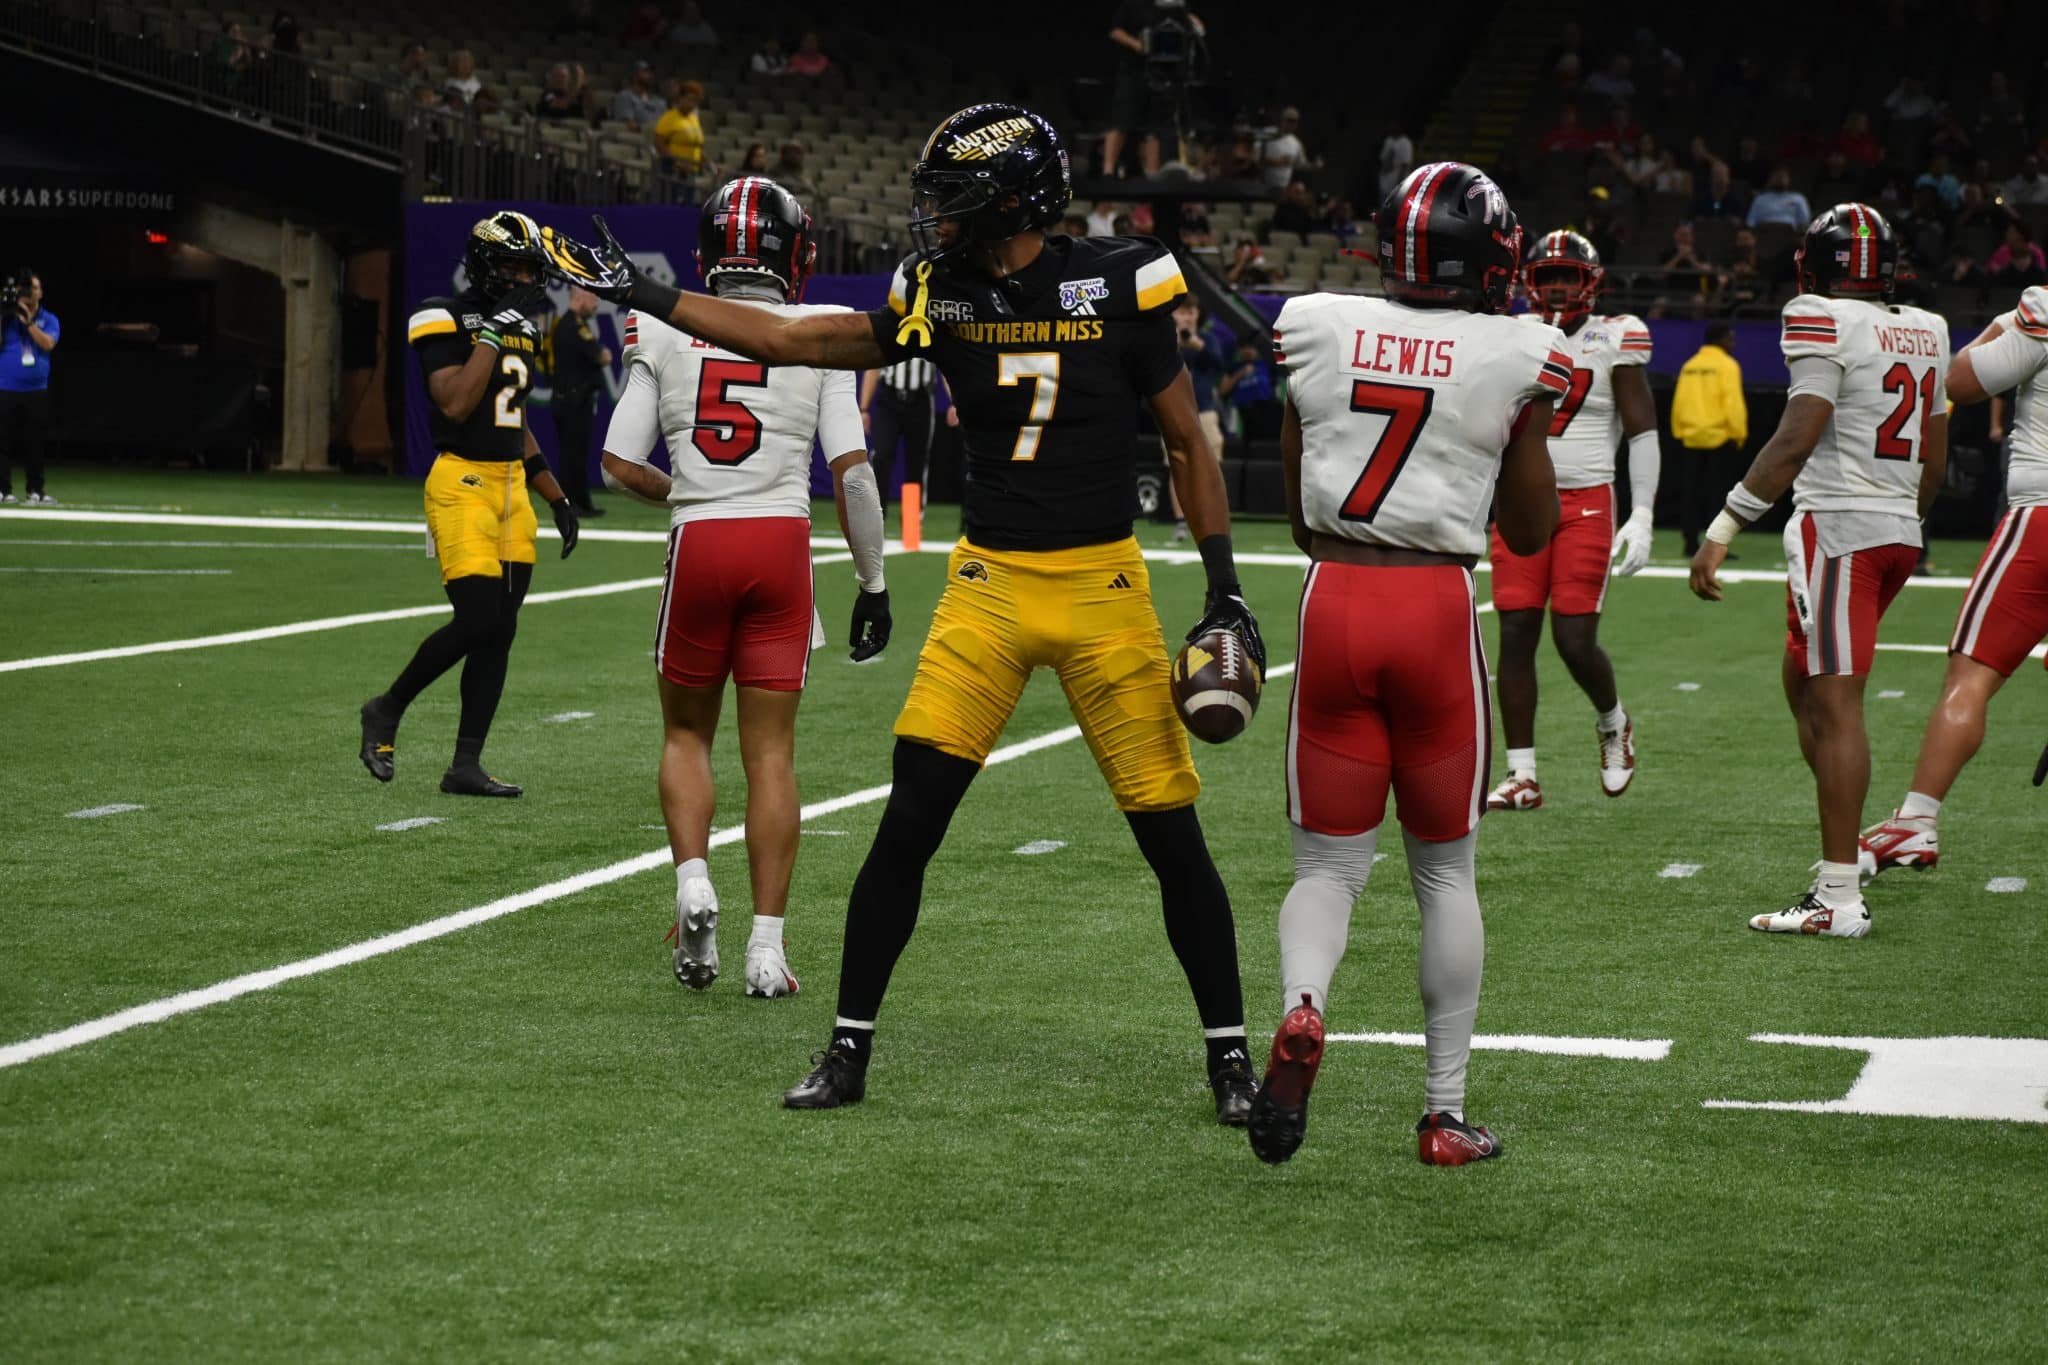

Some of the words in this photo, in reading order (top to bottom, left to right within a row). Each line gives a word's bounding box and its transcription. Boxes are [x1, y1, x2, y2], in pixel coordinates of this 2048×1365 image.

[946, 117, 1034, 157] SOUTHERN
[979, 134, 1017, 158] MISS
[67, 190, 174, 210] SUPERDOME
[1056, 320, 1104, 342] MISS
[1352, 330, 1454, 377] LEWIS
[1874, 325, 1939, 357] WESTER
[494, 353, 529, 429] 2
[691, 357, 768, 466] 5
[997, 352, 1061, 462] 7
[1874, 361, 1936, 464] 21
[1339, 379, 1435, 524] 7
